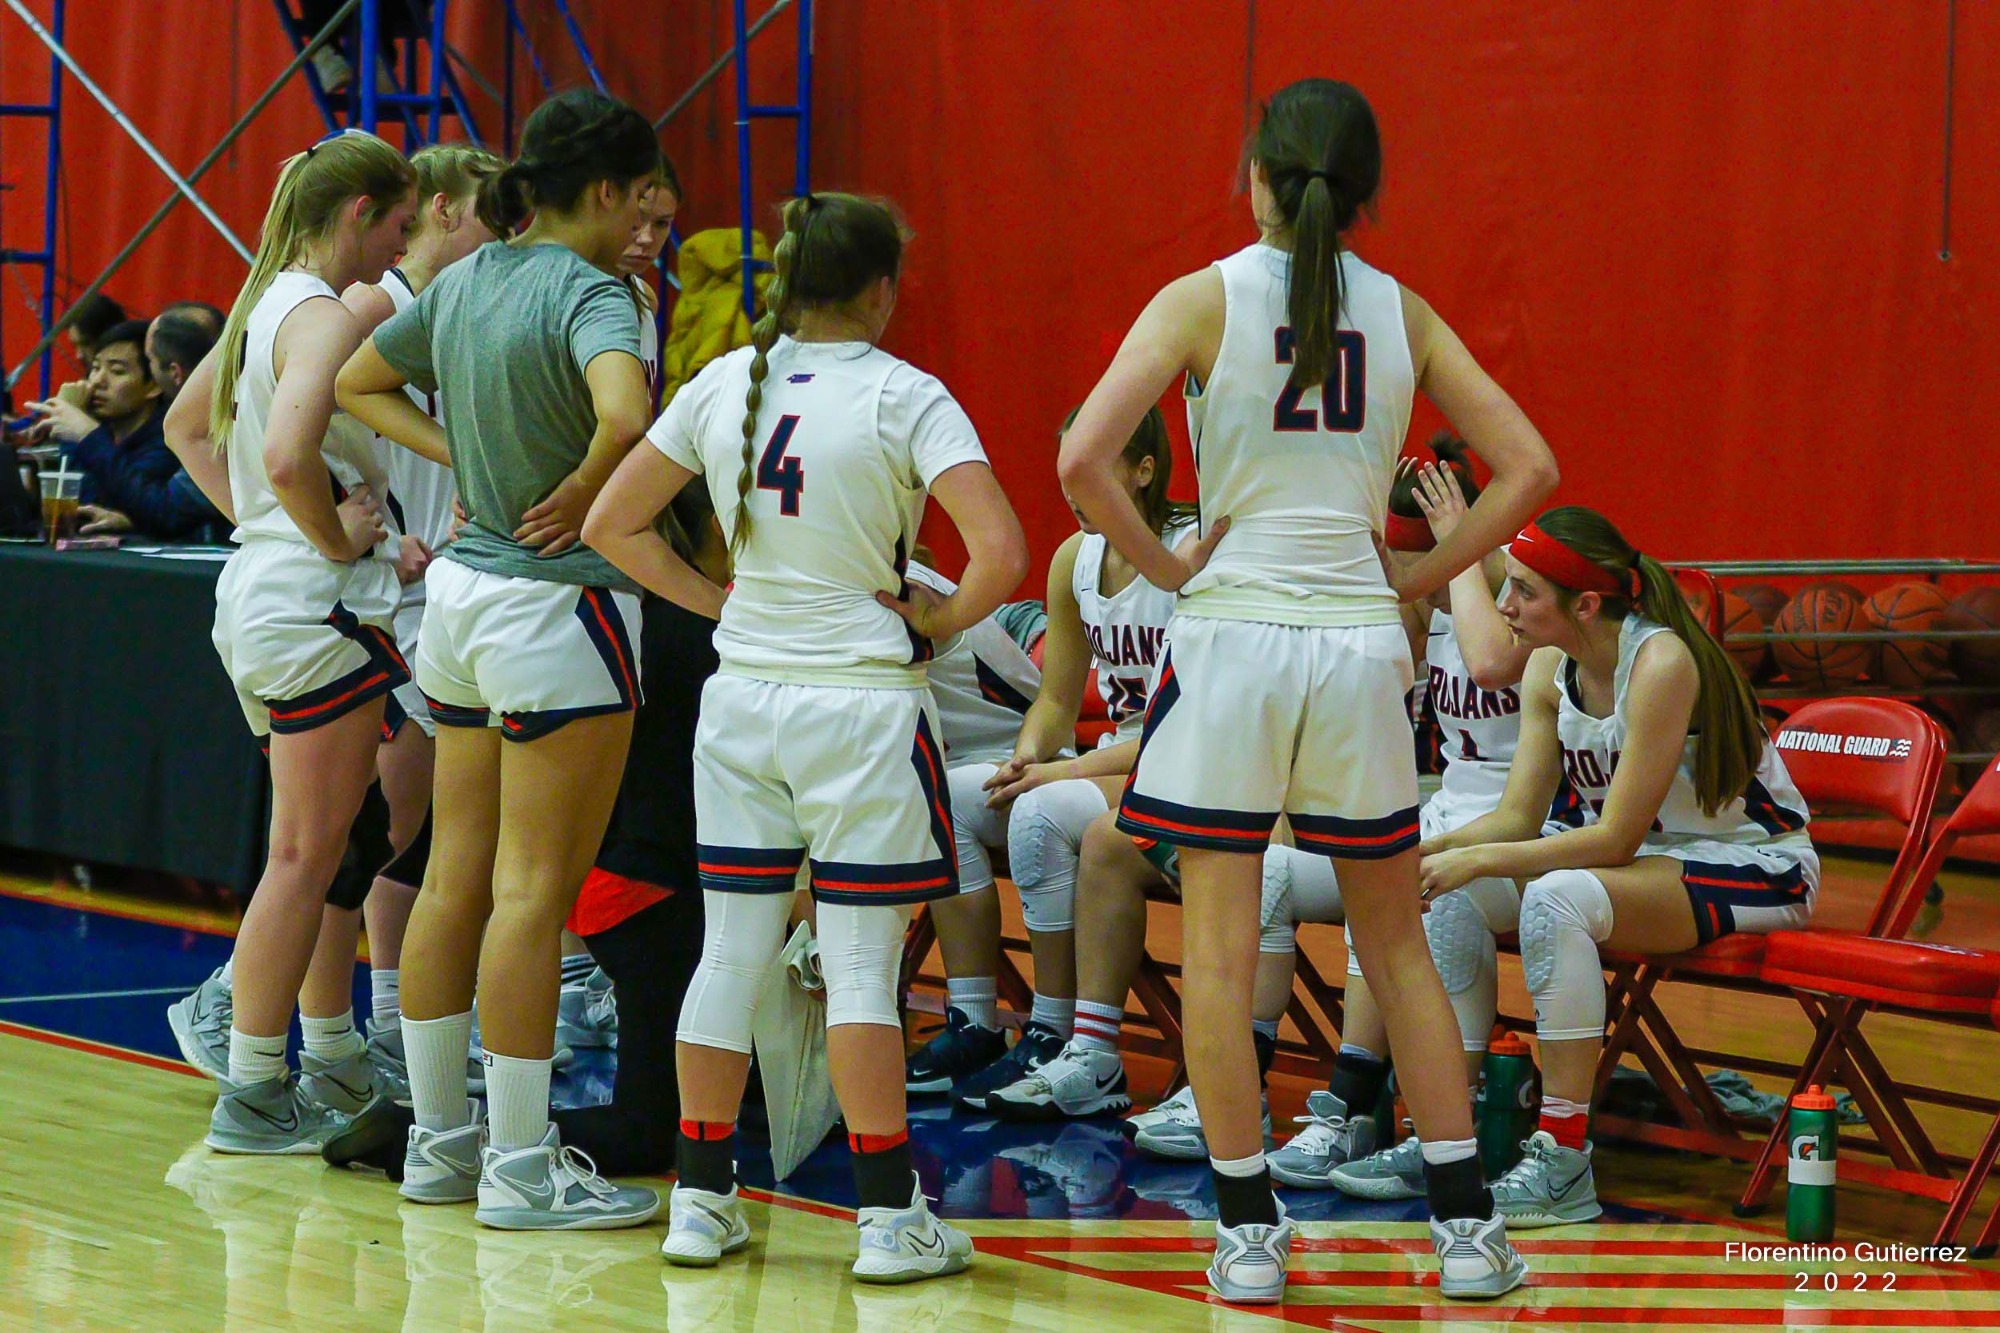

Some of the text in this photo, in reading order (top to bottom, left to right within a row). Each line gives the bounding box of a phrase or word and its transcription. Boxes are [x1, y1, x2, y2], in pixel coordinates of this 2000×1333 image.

[1273, 326, 1366, 433] 20
[756, 414, 804, 517] 4
[1775, 730, 1892, 757] NATIONAL GUARD
